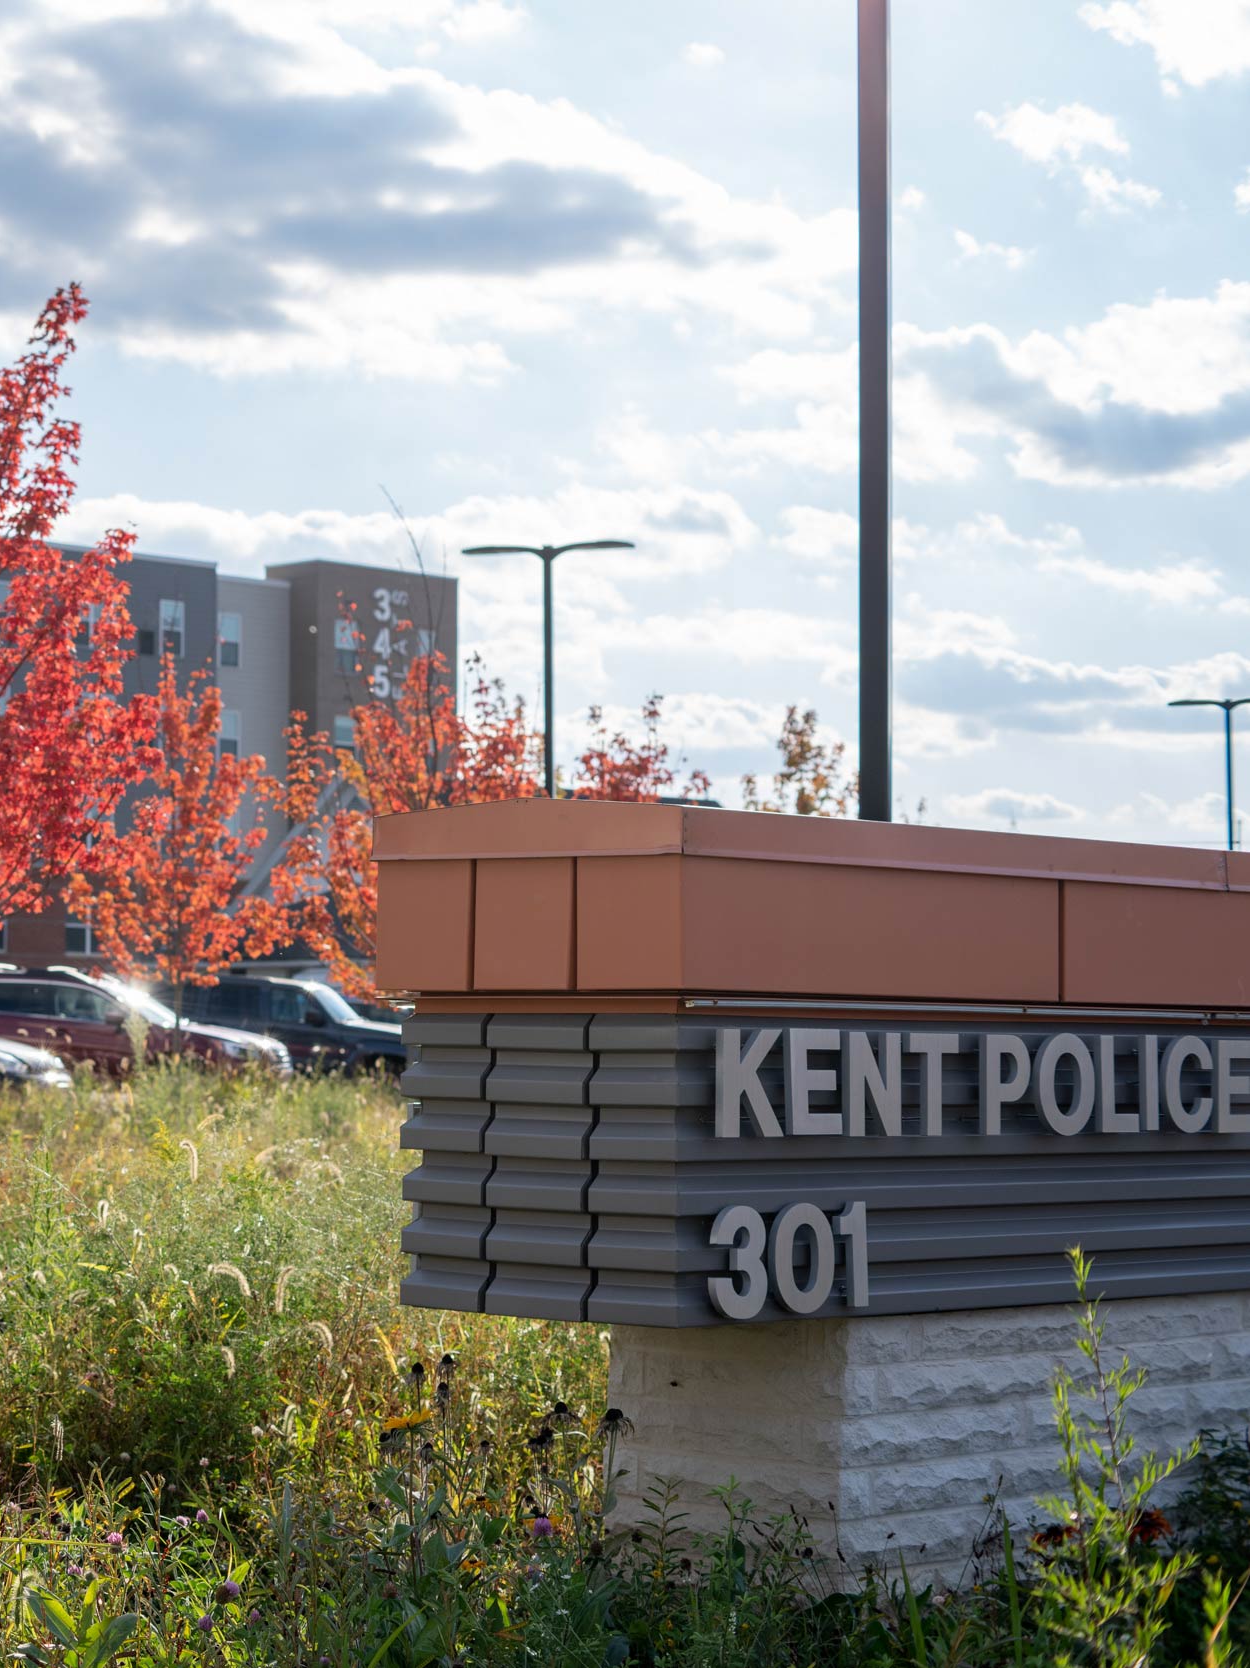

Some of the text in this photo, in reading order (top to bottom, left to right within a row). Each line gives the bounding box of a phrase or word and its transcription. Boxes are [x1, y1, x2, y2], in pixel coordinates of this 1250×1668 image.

[715, 1028, 1250, 1138] KENT POLICE
[707, 1200, 869, 1320] 301
